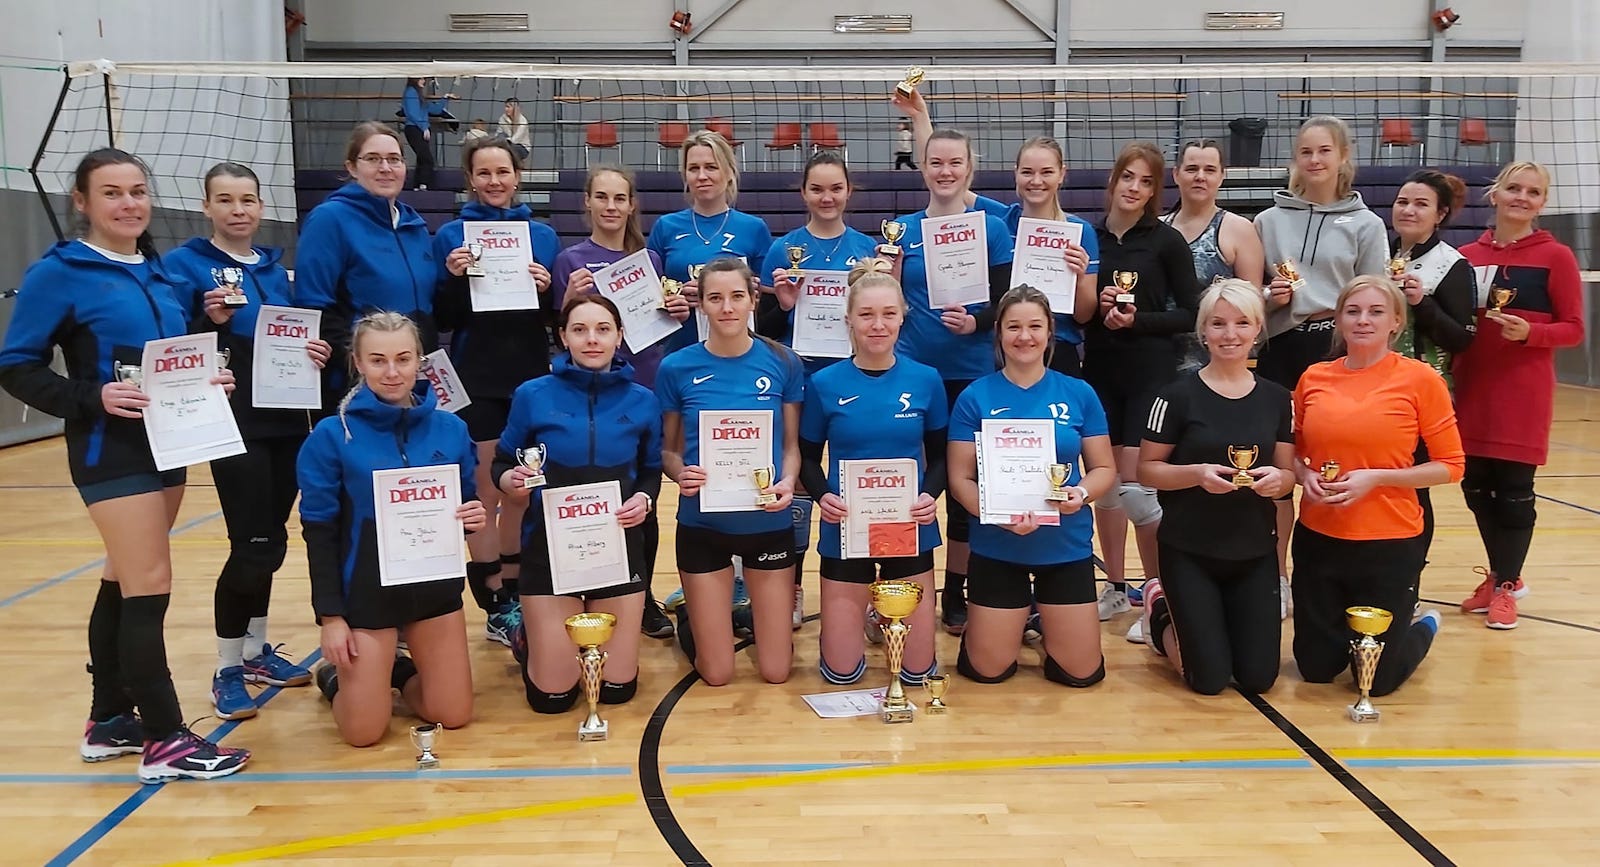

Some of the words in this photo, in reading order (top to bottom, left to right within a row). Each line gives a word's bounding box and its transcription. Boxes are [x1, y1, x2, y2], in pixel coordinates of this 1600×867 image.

[722, 232, 736, 246] 7
[933, 229, 977, 245] DIPLOM
[1027, 235, 1071, 250] DIPLOM
[608, 267, 647, 293] DIPLOM
[806, 284, 847, 297] DIPLOM
[265, 323, 310, 339] DIPLOM
[153, 353, 206, 373] DIPLOM
[755, 376, 771, 395] 9
[898, 392, 912, 412] 5
[1048, 402, 1070, 420] 12
[711, 427, 761, 440] DIPLOM
[994, 436, 1043, 449] DIPLOM
[857, 475, 906, 489] DIPLOM
[389, 485, 447, 504] DIPLOM
[556, 500, 610, 519] DIPLOM
